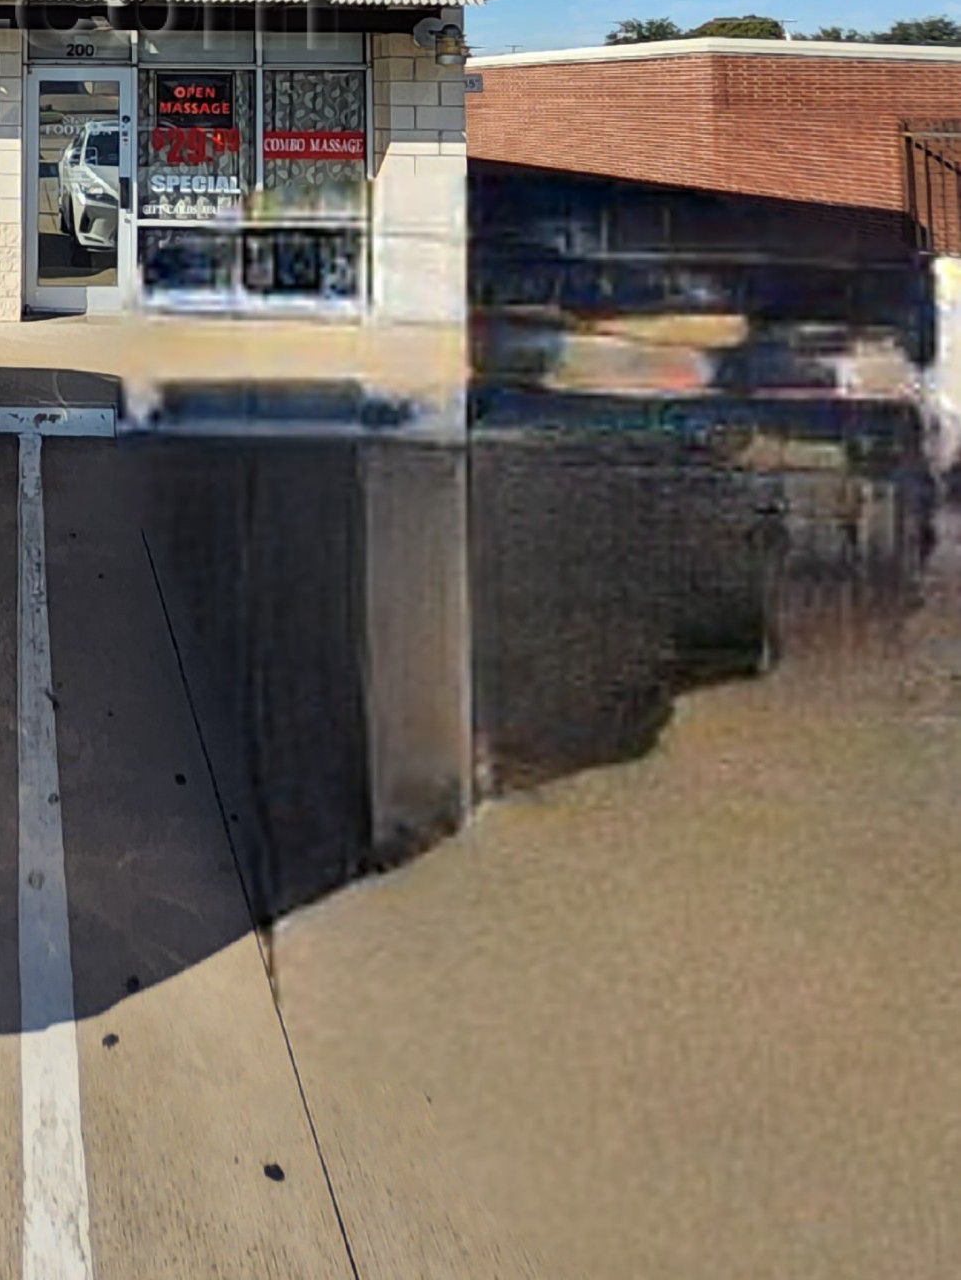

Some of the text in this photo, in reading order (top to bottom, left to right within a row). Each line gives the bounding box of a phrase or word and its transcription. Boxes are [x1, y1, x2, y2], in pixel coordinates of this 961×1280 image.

[65, 43, 95, 57] 200
[174, 86, 216, 98] OPEN
[159, 102, 231, 115] MASSAGE
[264, 138, 364, 153] COMBO MASSAGE
[150, 175, 241, 194] SPECIAL
